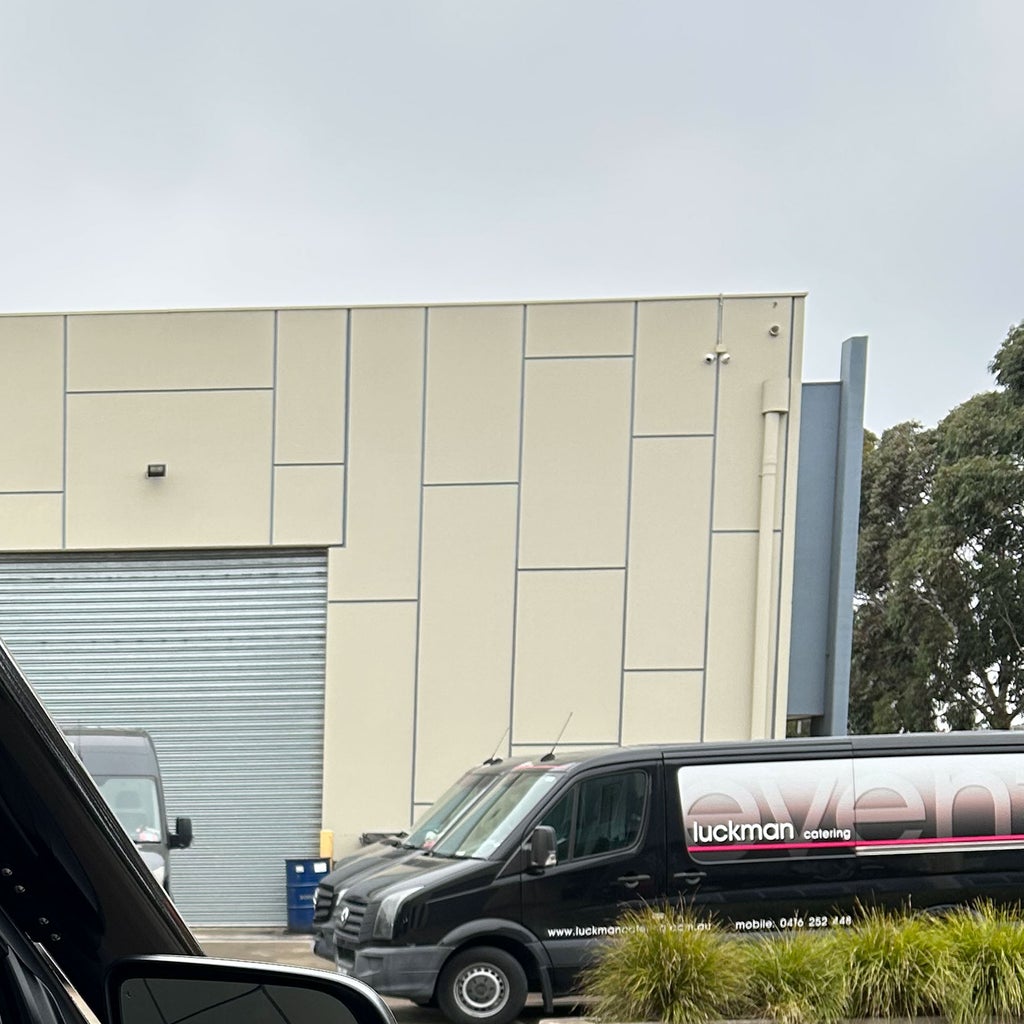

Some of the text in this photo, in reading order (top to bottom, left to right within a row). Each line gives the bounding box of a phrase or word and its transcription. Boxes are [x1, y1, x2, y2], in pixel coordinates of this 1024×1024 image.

[684, 769, 1024, 859] even
[693, 820, 851, 843] luckman catering
[735, 919, 776, 930] mobile:
[808, 916, 828, 927] 252
